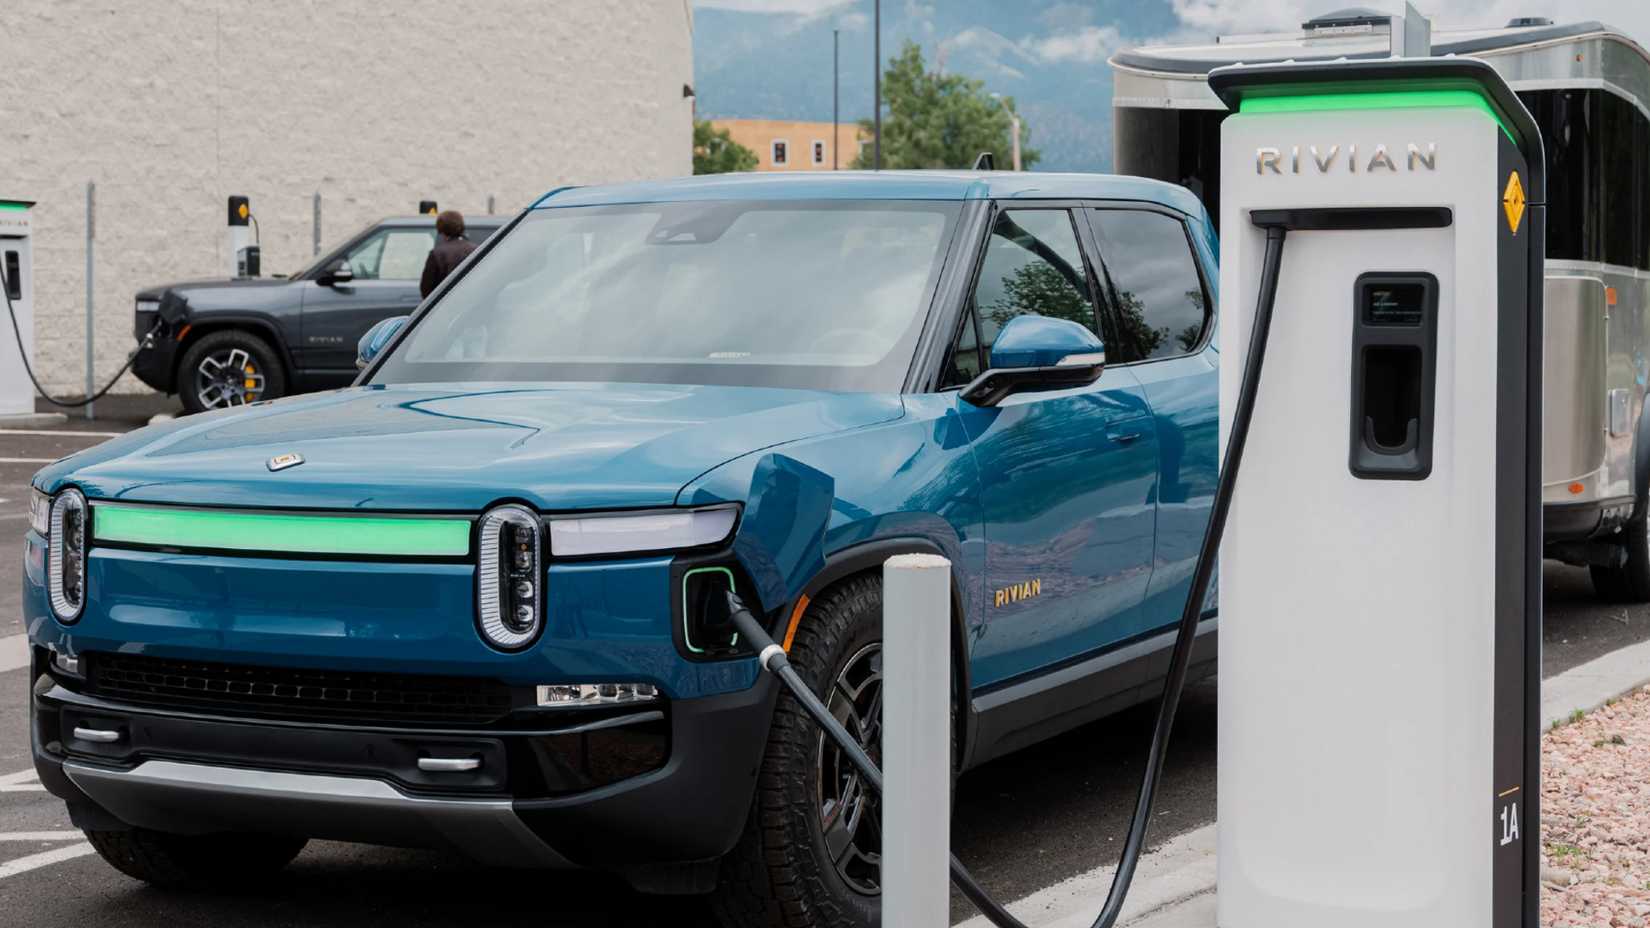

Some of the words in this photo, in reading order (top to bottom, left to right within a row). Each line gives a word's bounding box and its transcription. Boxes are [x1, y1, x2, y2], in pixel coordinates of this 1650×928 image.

[1256, 143, 1436, 175] RIVIAN
[994, 578, 1041, 608] RIVIAN
[1500, 802, 1519, 846] 1A
